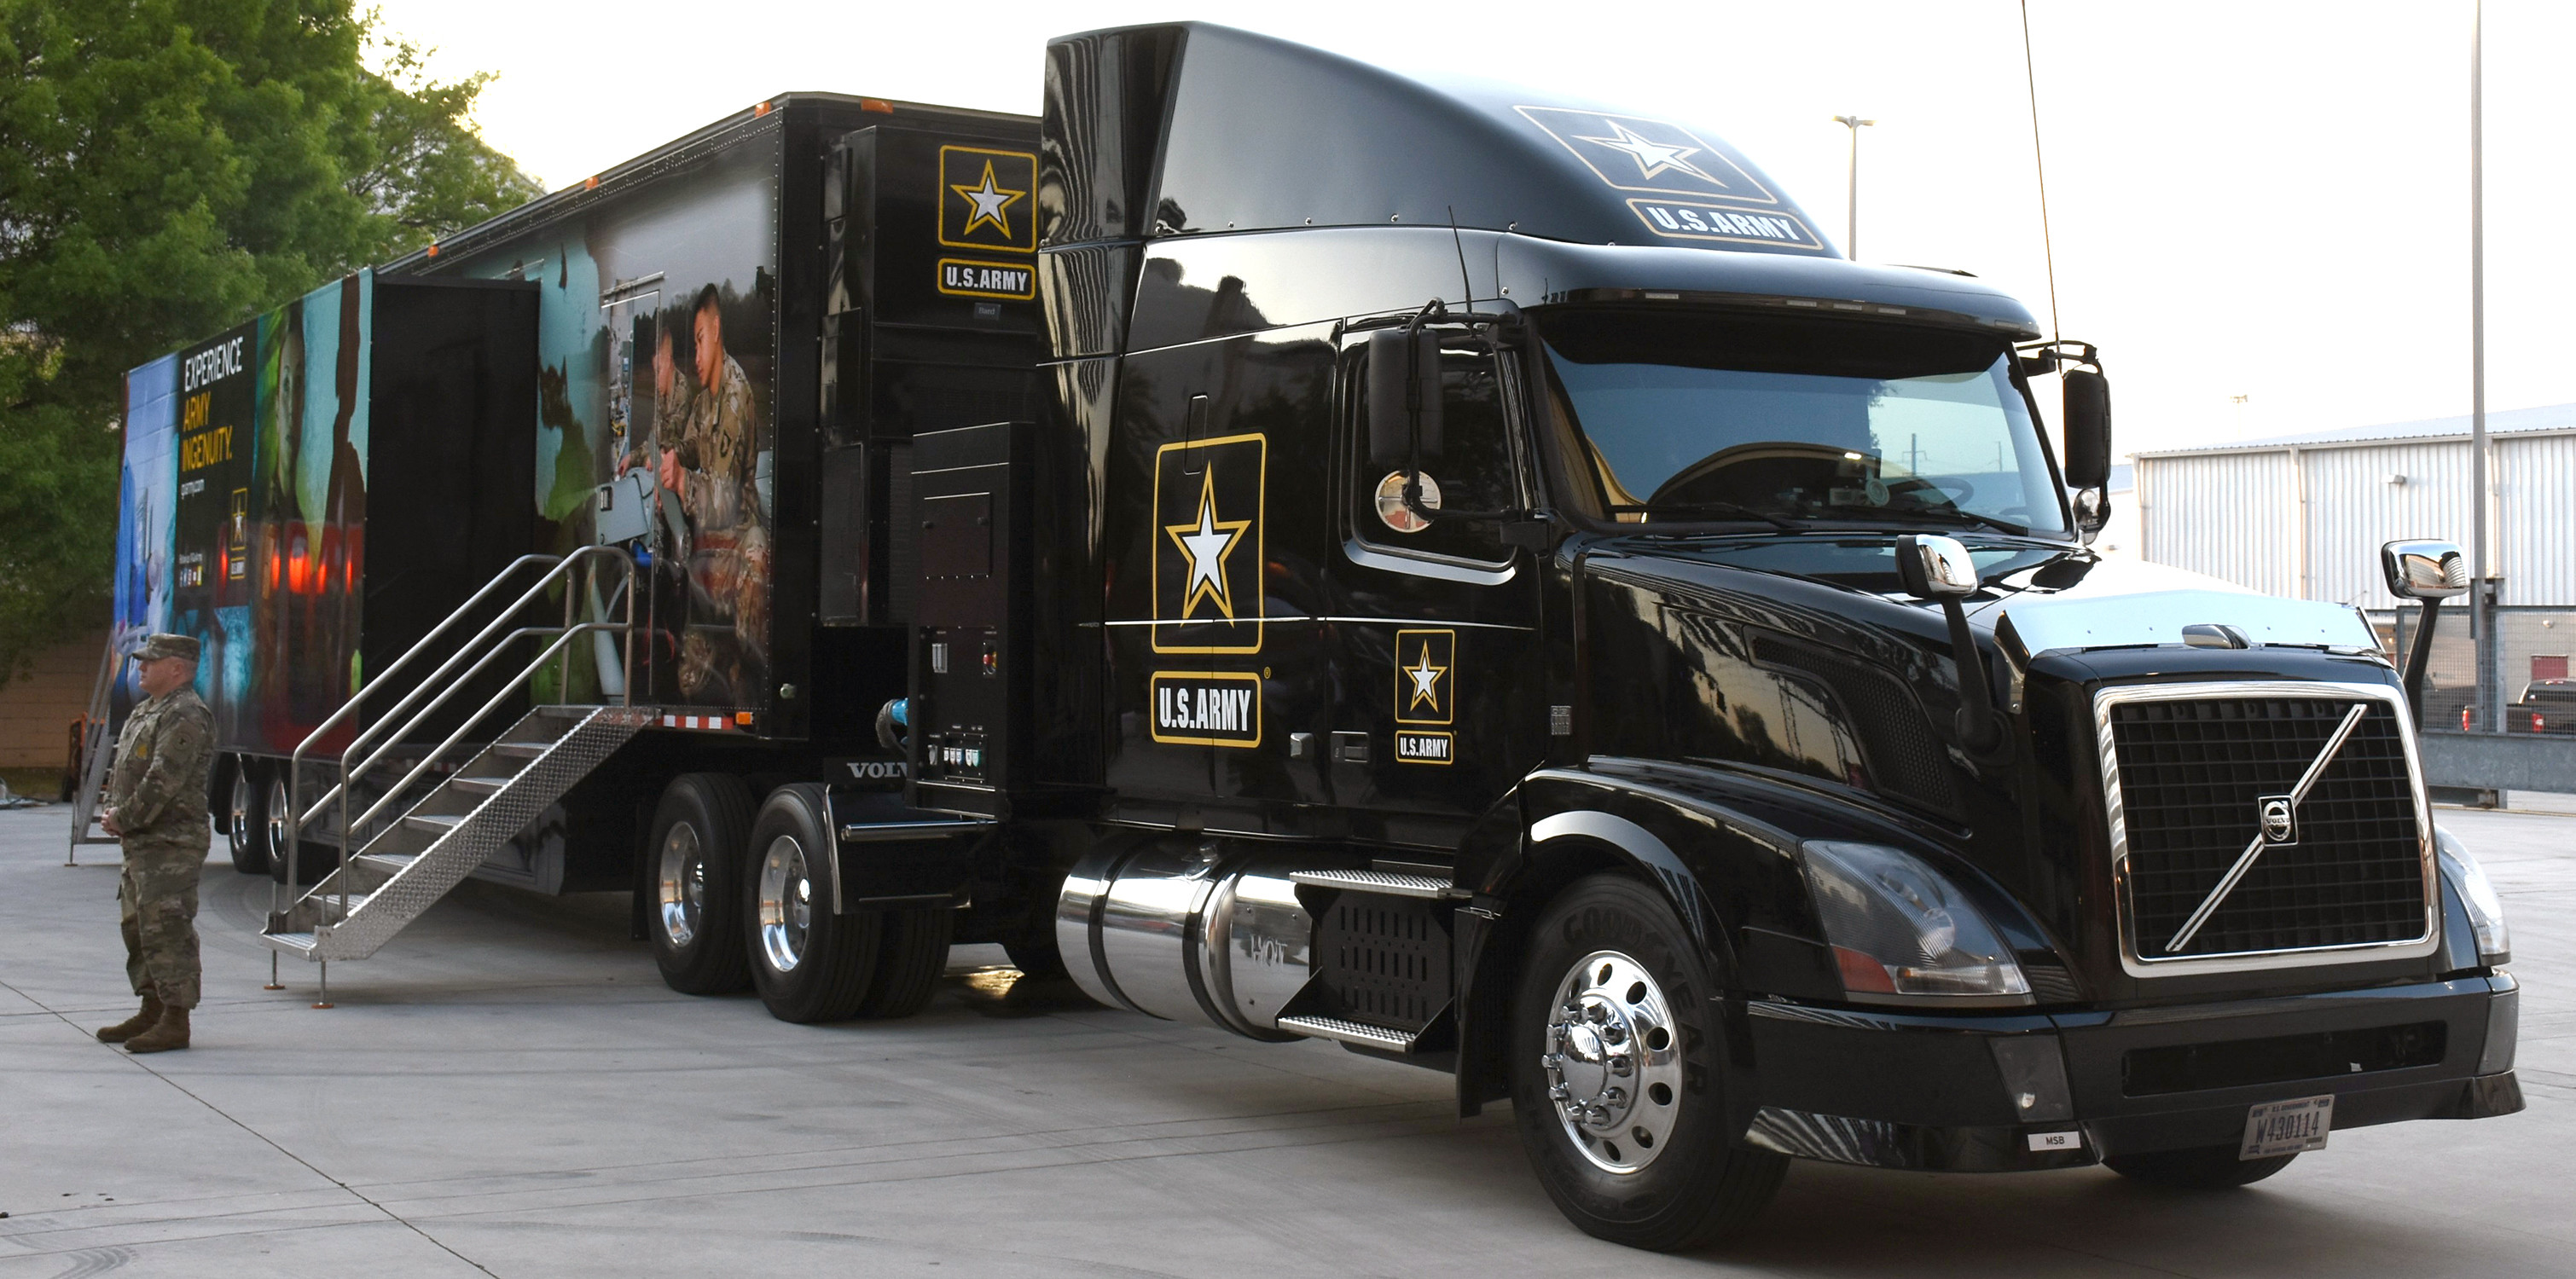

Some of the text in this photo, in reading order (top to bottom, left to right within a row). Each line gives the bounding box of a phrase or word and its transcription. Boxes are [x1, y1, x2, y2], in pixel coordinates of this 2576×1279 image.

[1645, 205, 1801, 241] U.S.ARMY
[946, 266, 1028, 292] U.S.ARMY
[184, 336, 243, 392] EXPERIENCE
[183, 391, 212, 432] ARMY
[182, 425, 233, 472] INGENUITY.
[1159, 686, 1251, 732] U.S.ARMY
[1399, 737, 1448, 759] U.S.ARMY
[1250, 934, 1288, 969] HOT
[1563, 906, 1709, 1096] GOODYEAR
[2045, 1136, 2065, 1145] MSB
[2255, 1111, 2319, 1143] W430114
